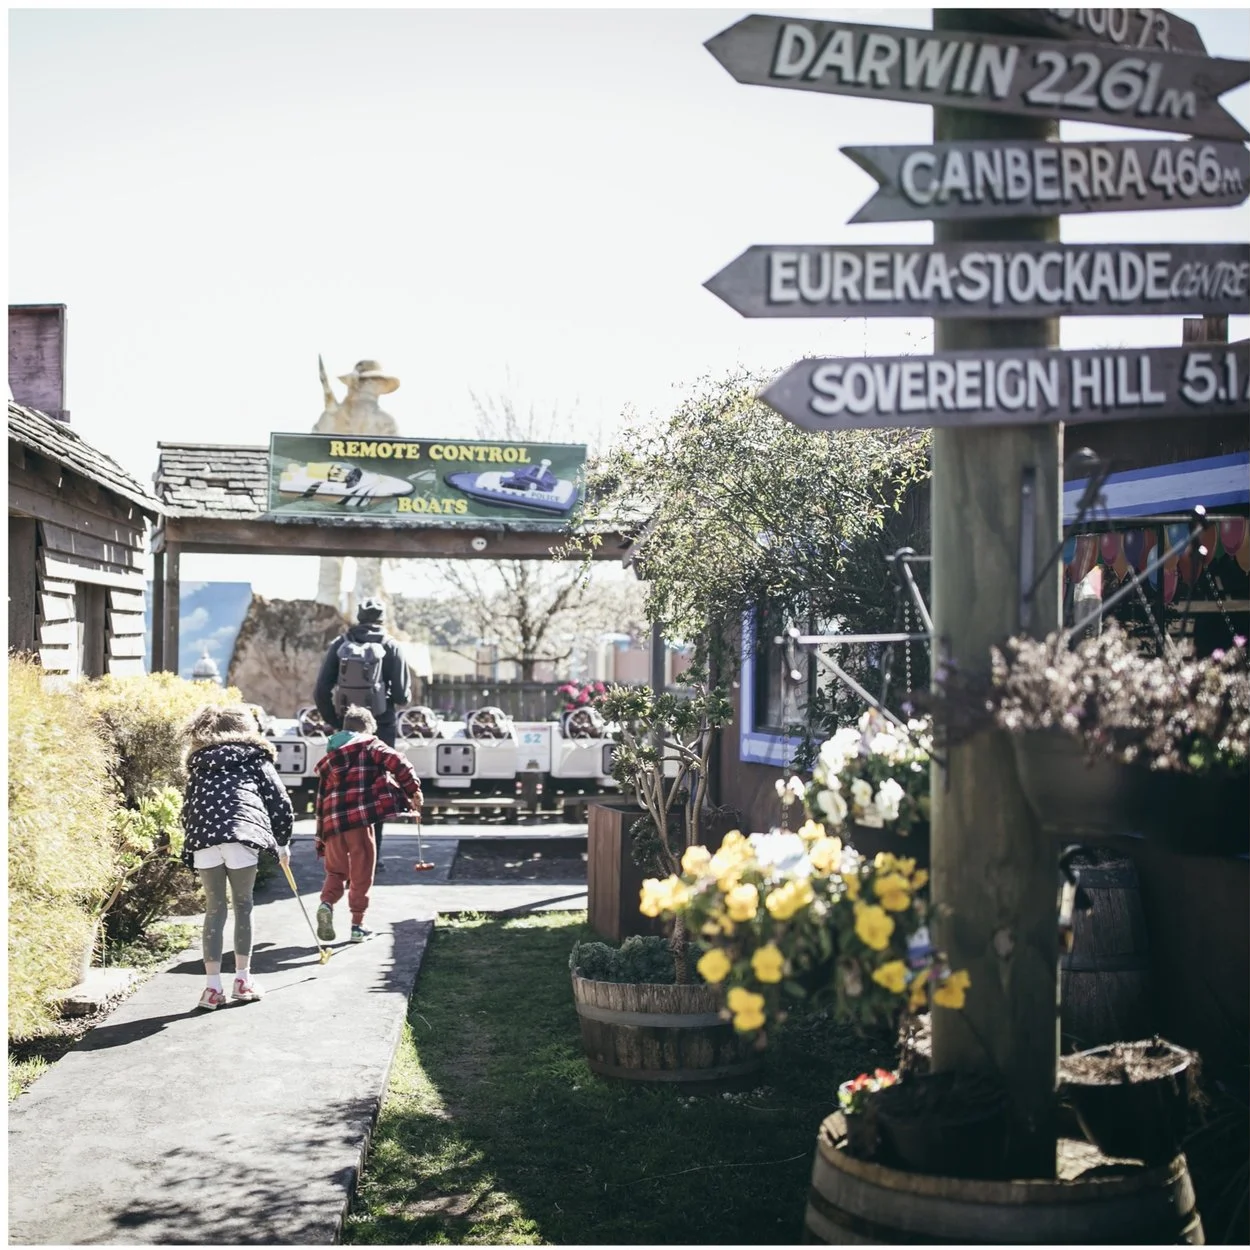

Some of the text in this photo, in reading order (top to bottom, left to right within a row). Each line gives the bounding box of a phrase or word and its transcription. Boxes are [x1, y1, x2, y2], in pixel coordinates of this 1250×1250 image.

[771, 25, 1019, 97] DARWIN
[901, 146, 1148, 206] CANBERRA
[1170, 260, 1250, 298] CENTRE
[810, 350, 1250, 415] SOVEREIGN HILL 5.1
[329, 440, 531, 464] REMOTE CONTROL
[397, 496, 468, 515] BOATS
